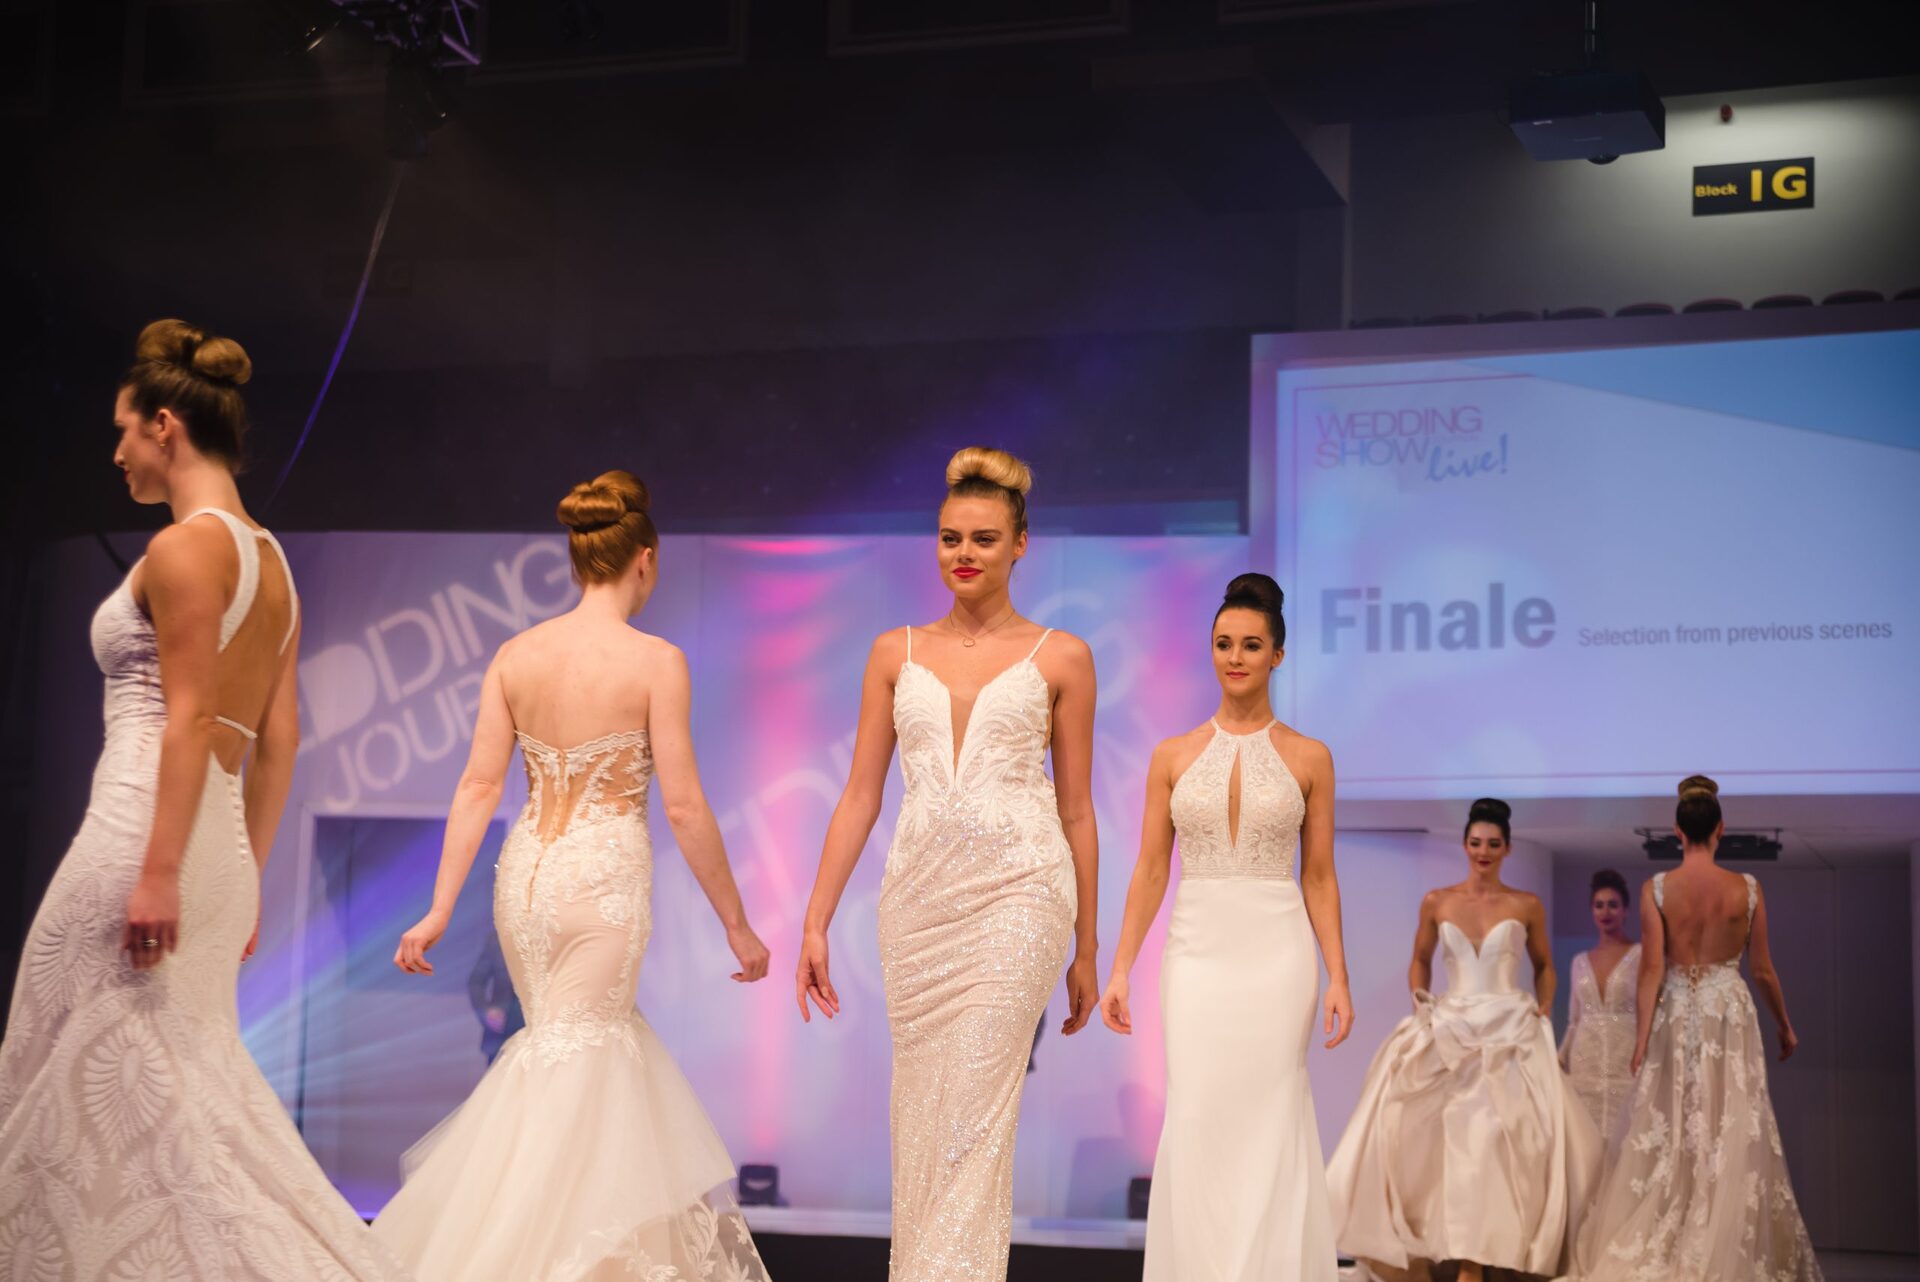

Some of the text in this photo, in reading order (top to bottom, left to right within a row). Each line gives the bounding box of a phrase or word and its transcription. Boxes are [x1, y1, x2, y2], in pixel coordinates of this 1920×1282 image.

[1695, 182, 1738, 197] Block
[1315, 405, 1483, 440] WEDDING
[1314, 432, 1508, 482] SHOW live!
[1321, 582, 1556, 654] Finale
[1578, 620, 1893, 648] Selection from previous scenes
